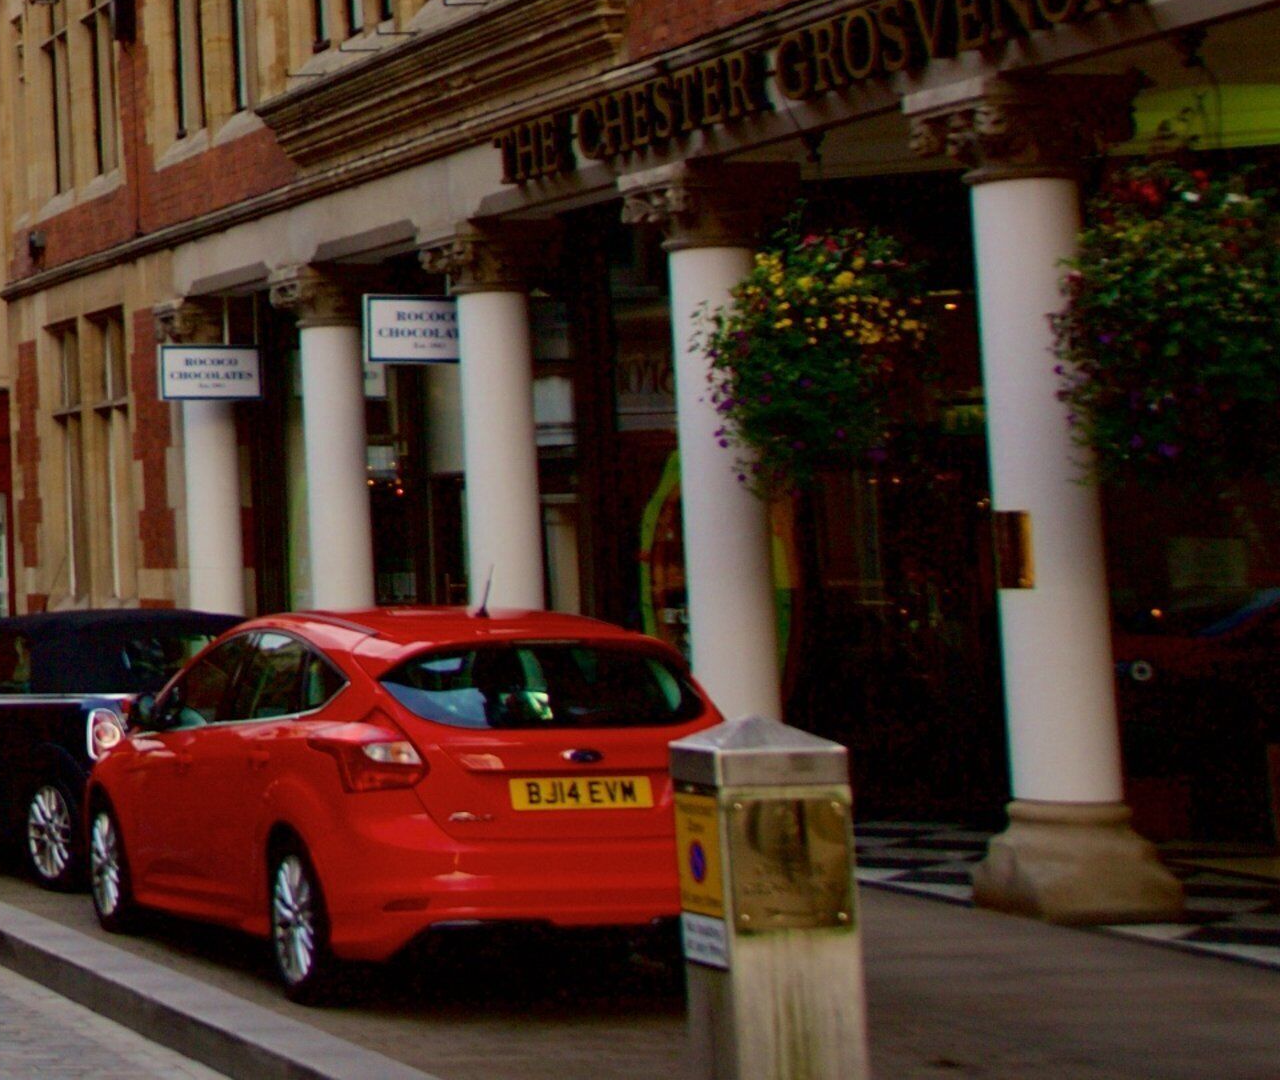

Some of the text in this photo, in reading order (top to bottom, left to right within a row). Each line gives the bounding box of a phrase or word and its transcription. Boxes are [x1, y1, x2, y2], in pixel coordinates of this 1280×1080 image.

[491, 114, 570, 185] THE
[577, 51, 764, 161] CHESTER
[184, 358, 238, 368] ROCOCO
[169, 370, 254, 380] CHOCOLATES
[526, 780, 637, 805] BJ14 EVM
